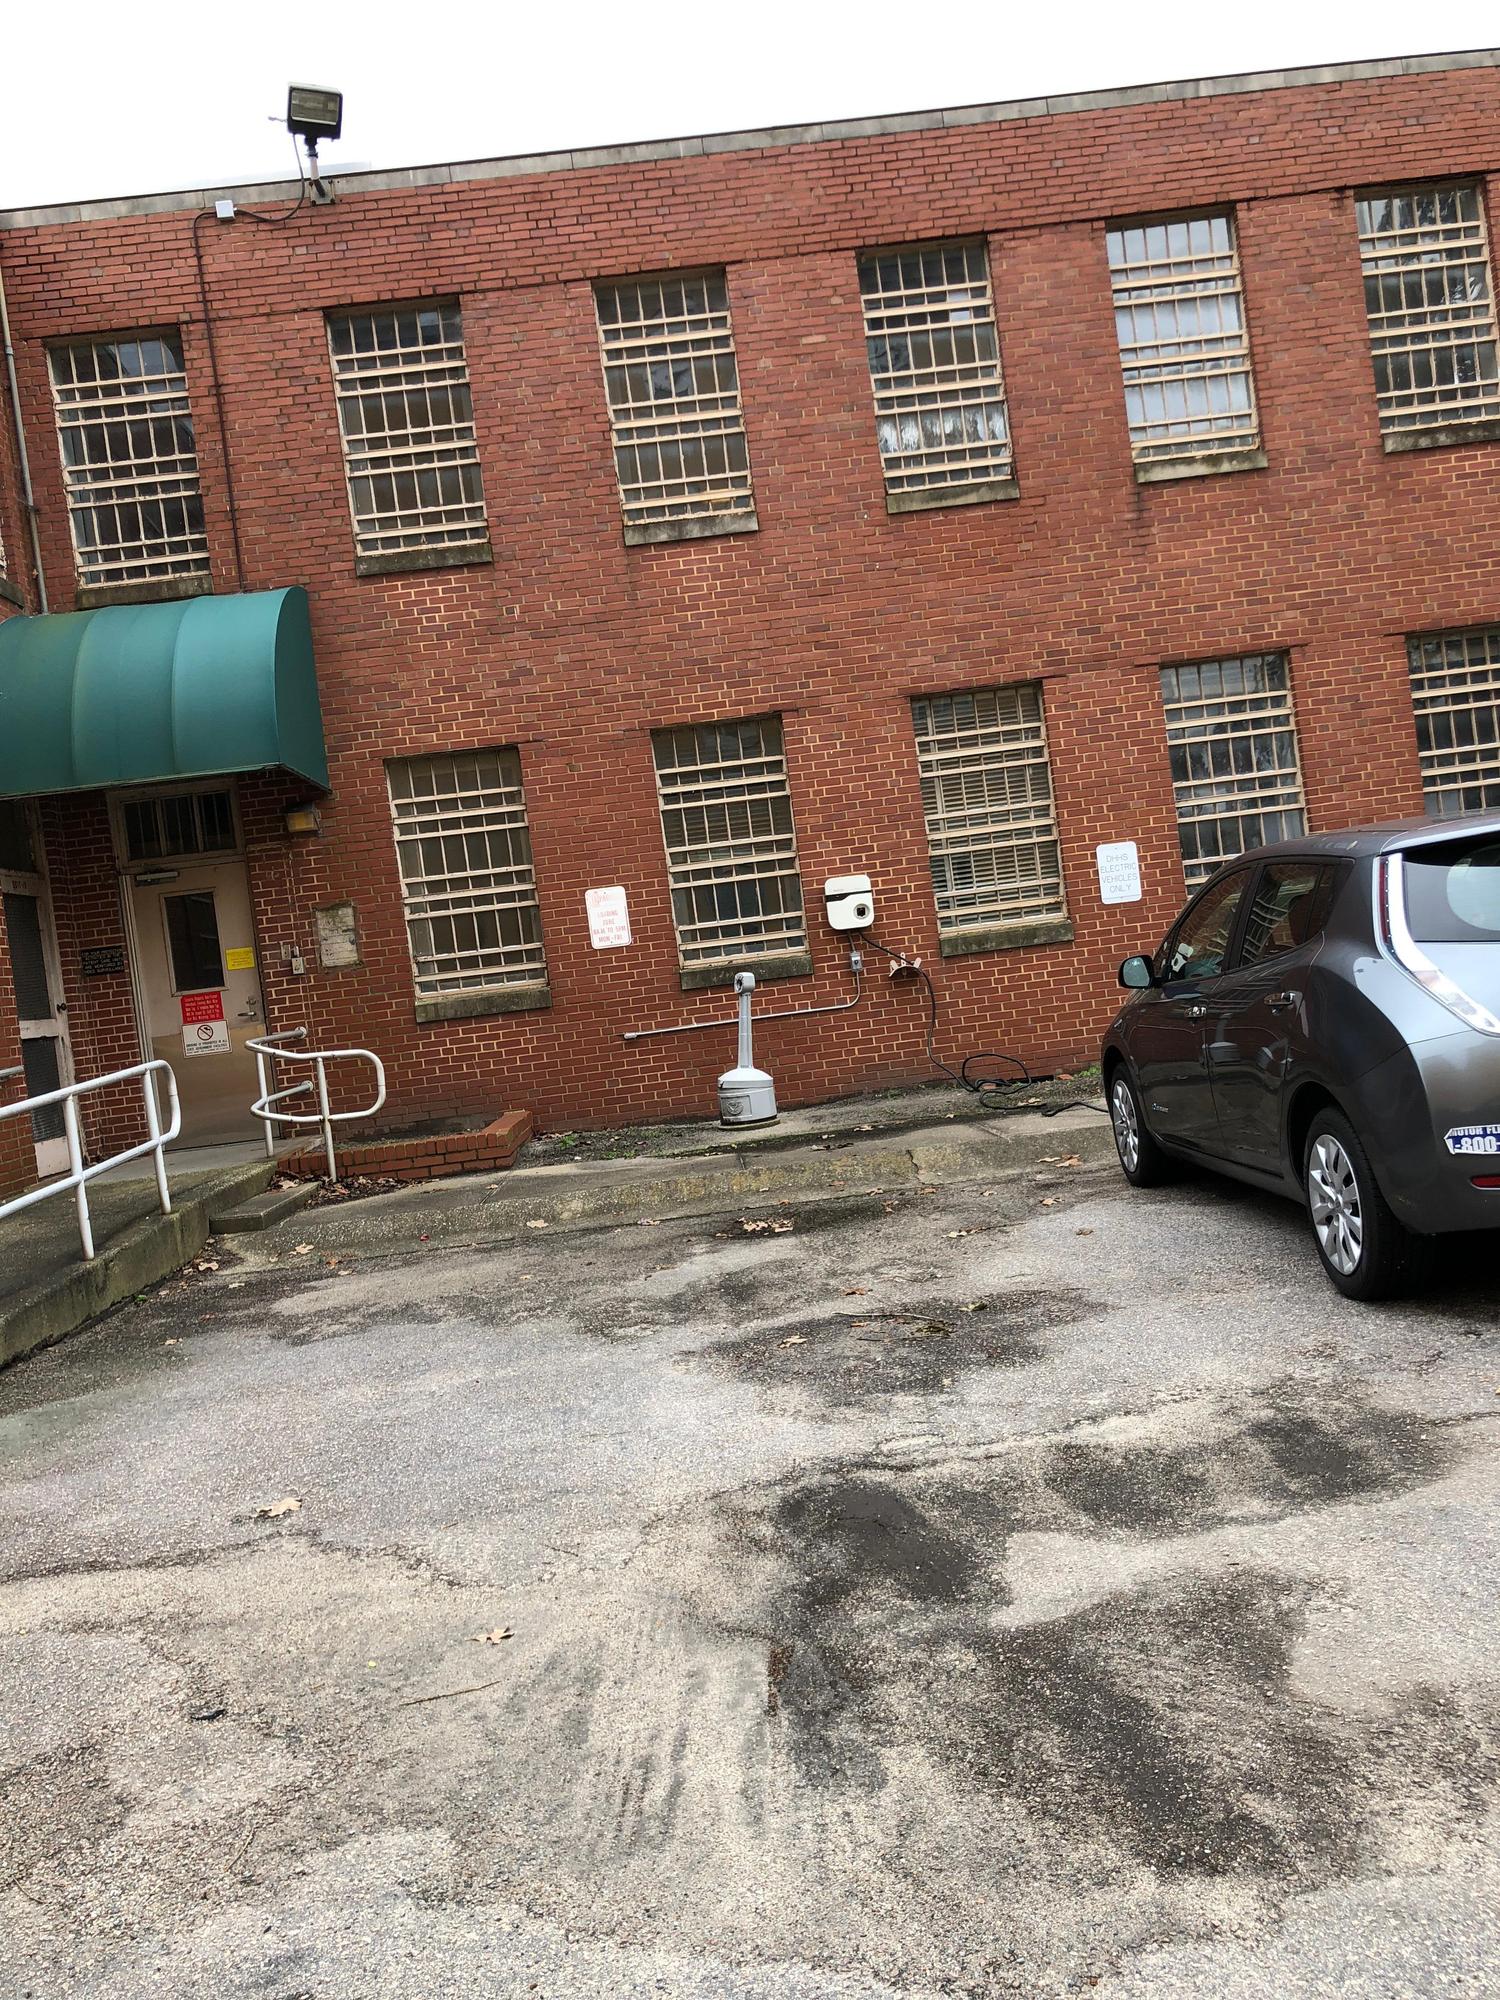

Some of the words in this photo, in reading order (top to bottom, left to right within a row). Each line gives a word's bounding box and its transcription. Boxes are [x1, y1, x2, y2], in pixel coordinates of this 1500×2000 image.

[1106, 854, 1128, 862] DHHS
[1100, 862, 1137, 873] ELECTRIC
[1102, 873, 1138, 883] VEHICLES
[1110, 884, 1132, 892] ONLY
